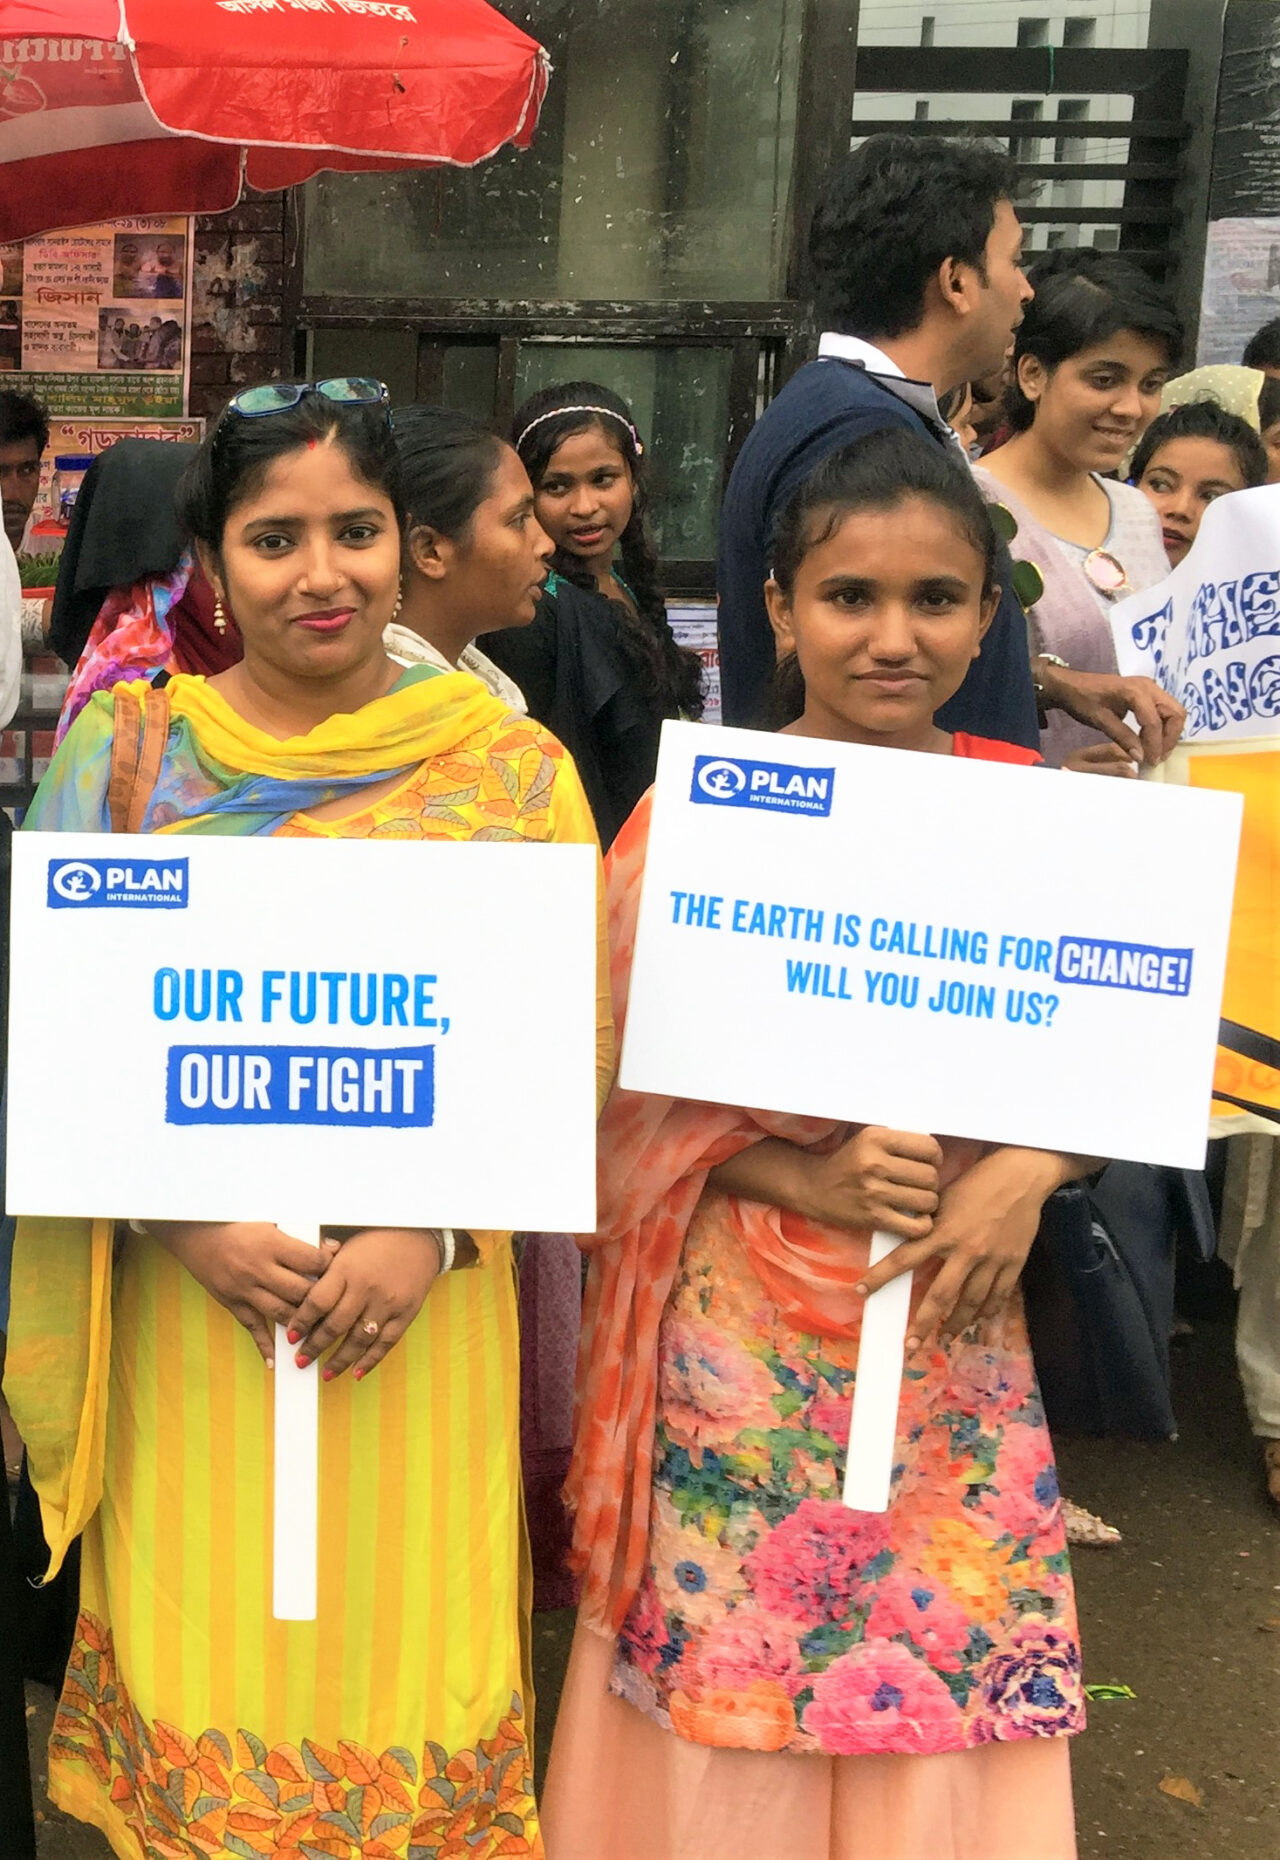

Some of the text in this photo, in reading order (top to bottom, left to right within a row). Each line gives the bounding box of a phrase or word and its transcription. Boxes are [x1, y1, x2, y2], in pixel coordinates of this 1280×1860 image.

[35, 286, 103, 306] জিসান
[751, 770, 828, 800] PLAN
[749, 794, 825, 812] INTERNATIONAL
[106, 867, 183, 891] PLAN
[106, 893, 182, 902] INTERNATIONAL
[670, 891, 1188, 993] THE EARTH IS CALLING FOR CHANGE!
[153, 966, 451, 1035] OUR FUTURE,
[785, 959, 1061, 1028] WILL YOU JOIN US?
[180, 1053, 424, 1114] OUR FIGHT
